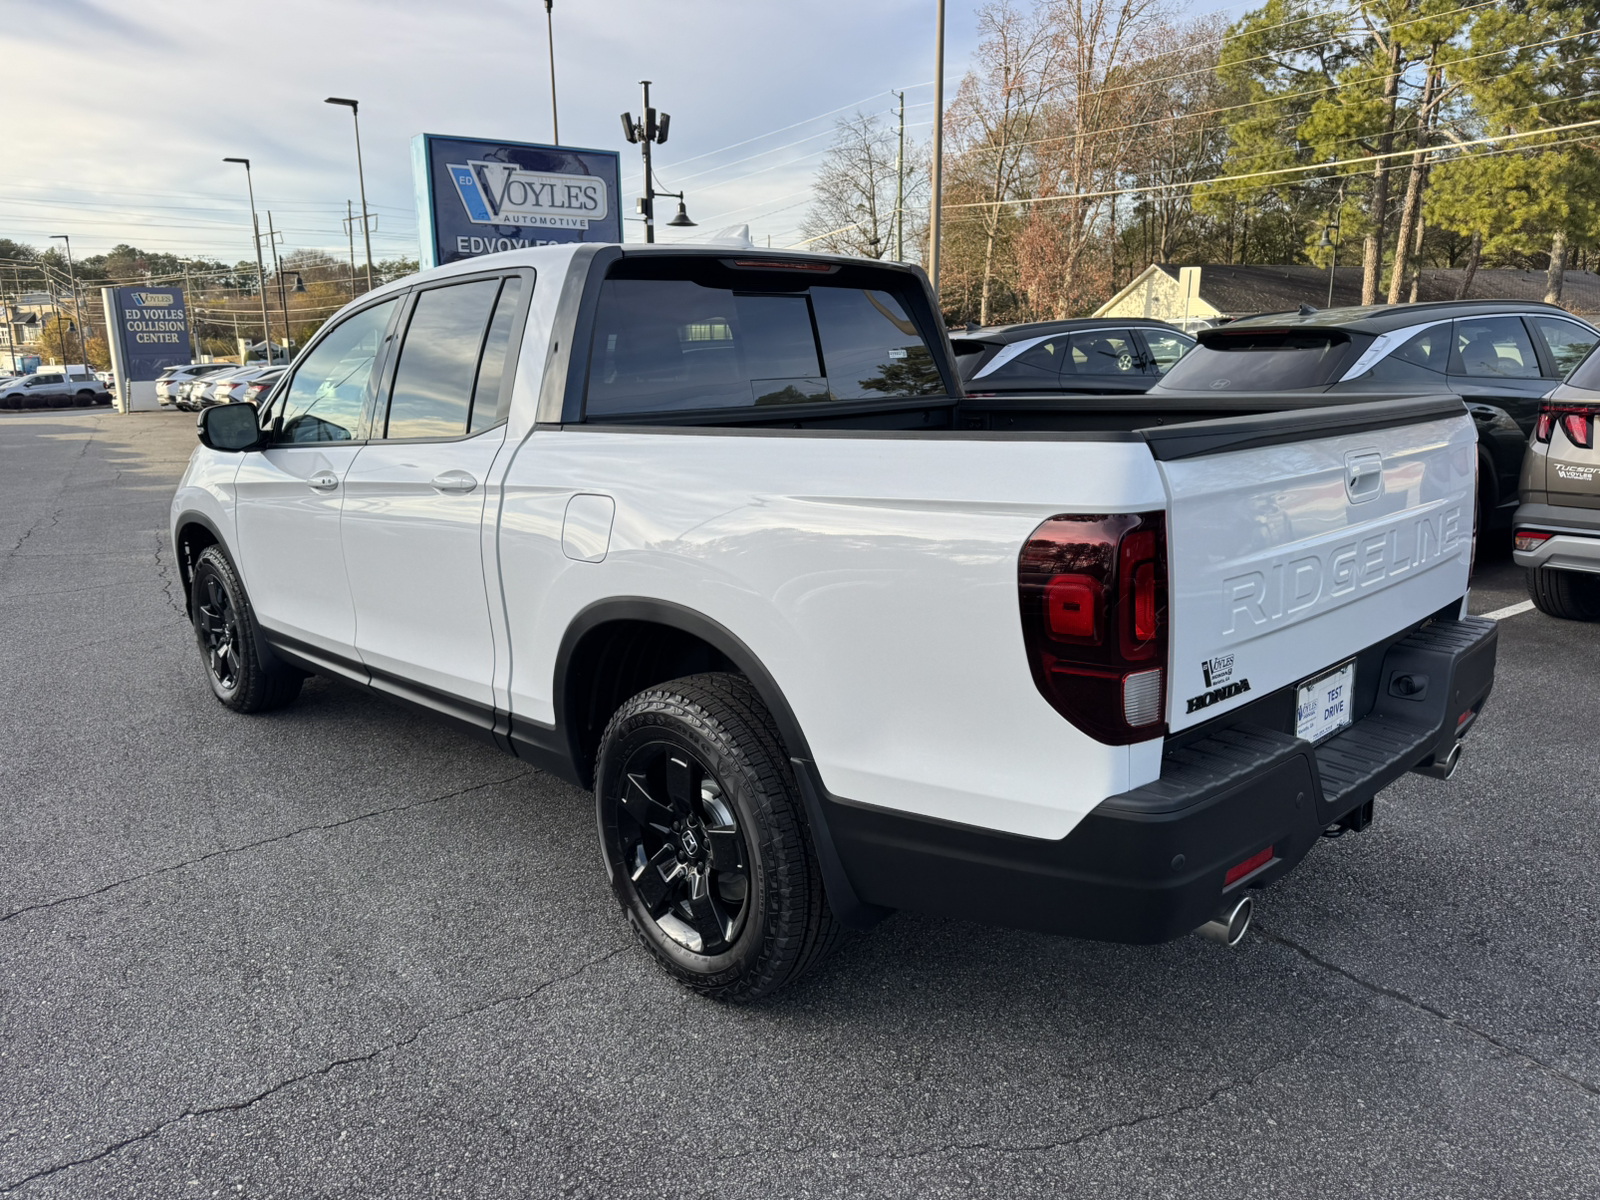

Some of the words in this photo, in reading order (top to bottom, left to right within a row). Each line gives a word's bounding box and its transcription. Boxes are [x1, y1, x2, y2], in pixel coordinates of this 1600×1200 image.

[459, 175, 473, 185] ED
[471, 164, 598, 216] VOYLES
[503, 214, 587, 228] AUTOMOTIVE
[138, 293, 171, 304] VOYLES
[125, 309, 141, 319] ED
[143, 309, 184, 319] VOYLES
[127, 321, 185, 331] COLLISION
[136, 333, 180, 343] CENTER
[1222, 506, 1461, 635] RIDGELINE
[1186, 678, 1251, 714] HONDA
[1327, 685, 1343, 703] TEST
[1324, 700, 1344, 720] DRIVE
